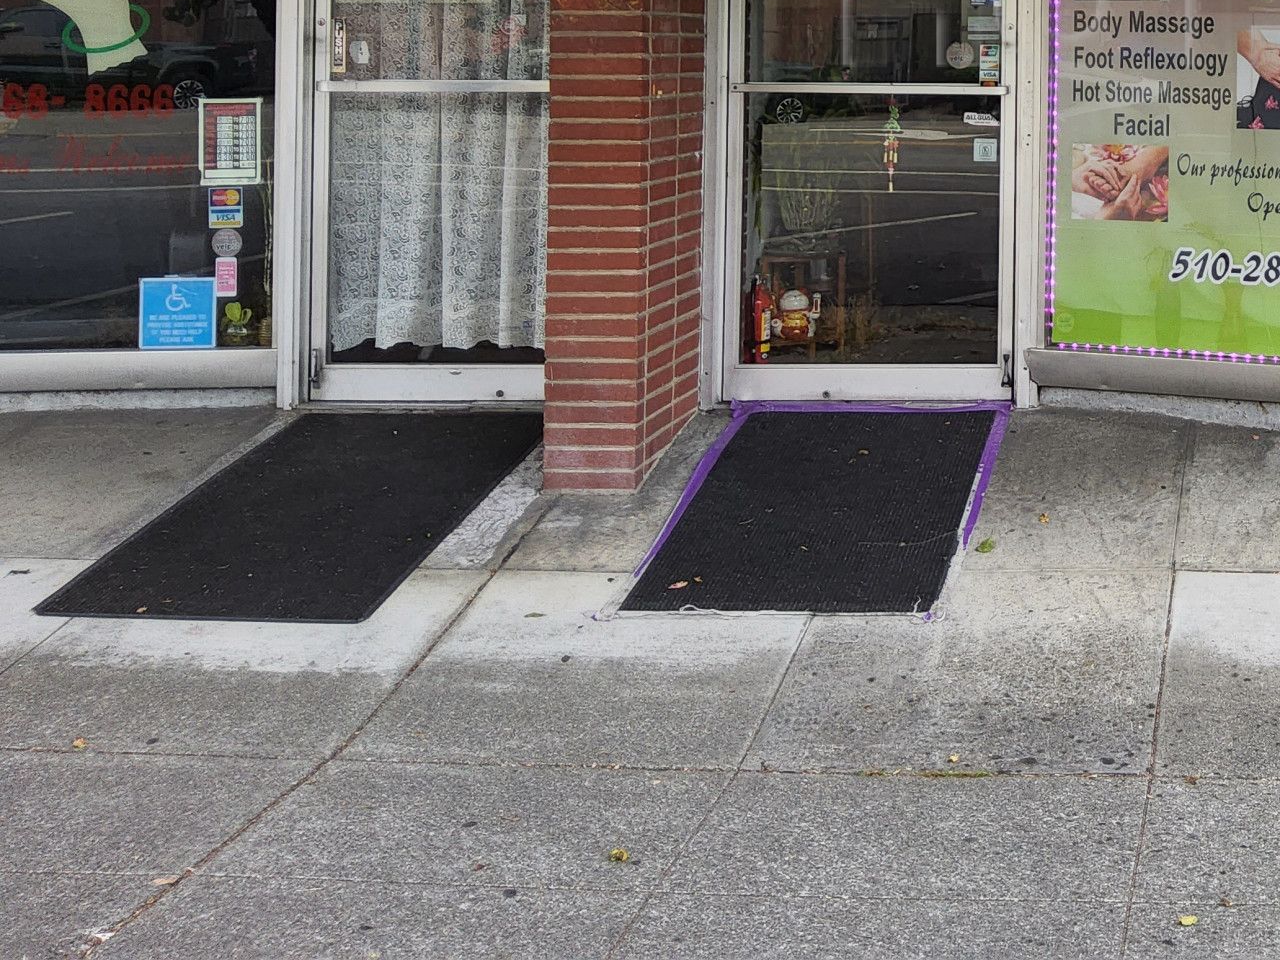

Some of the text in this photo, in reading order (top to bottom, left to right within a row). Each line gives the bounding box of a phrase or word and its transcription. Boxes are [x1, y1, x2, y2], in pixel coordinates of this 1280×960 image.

[334, 20, 344, 56] PUSH
[1073, 9, 1215, 41] Body Massage
[1073, 45, 1228, 77] Foot Reflexology
[1072, 80, 1232, 112] Hot Stone Massage
[1112, 113, 1171, 138] Facial
[1176, 153, 1207, 177] Our
[216, 213, 236, 221] VISA
